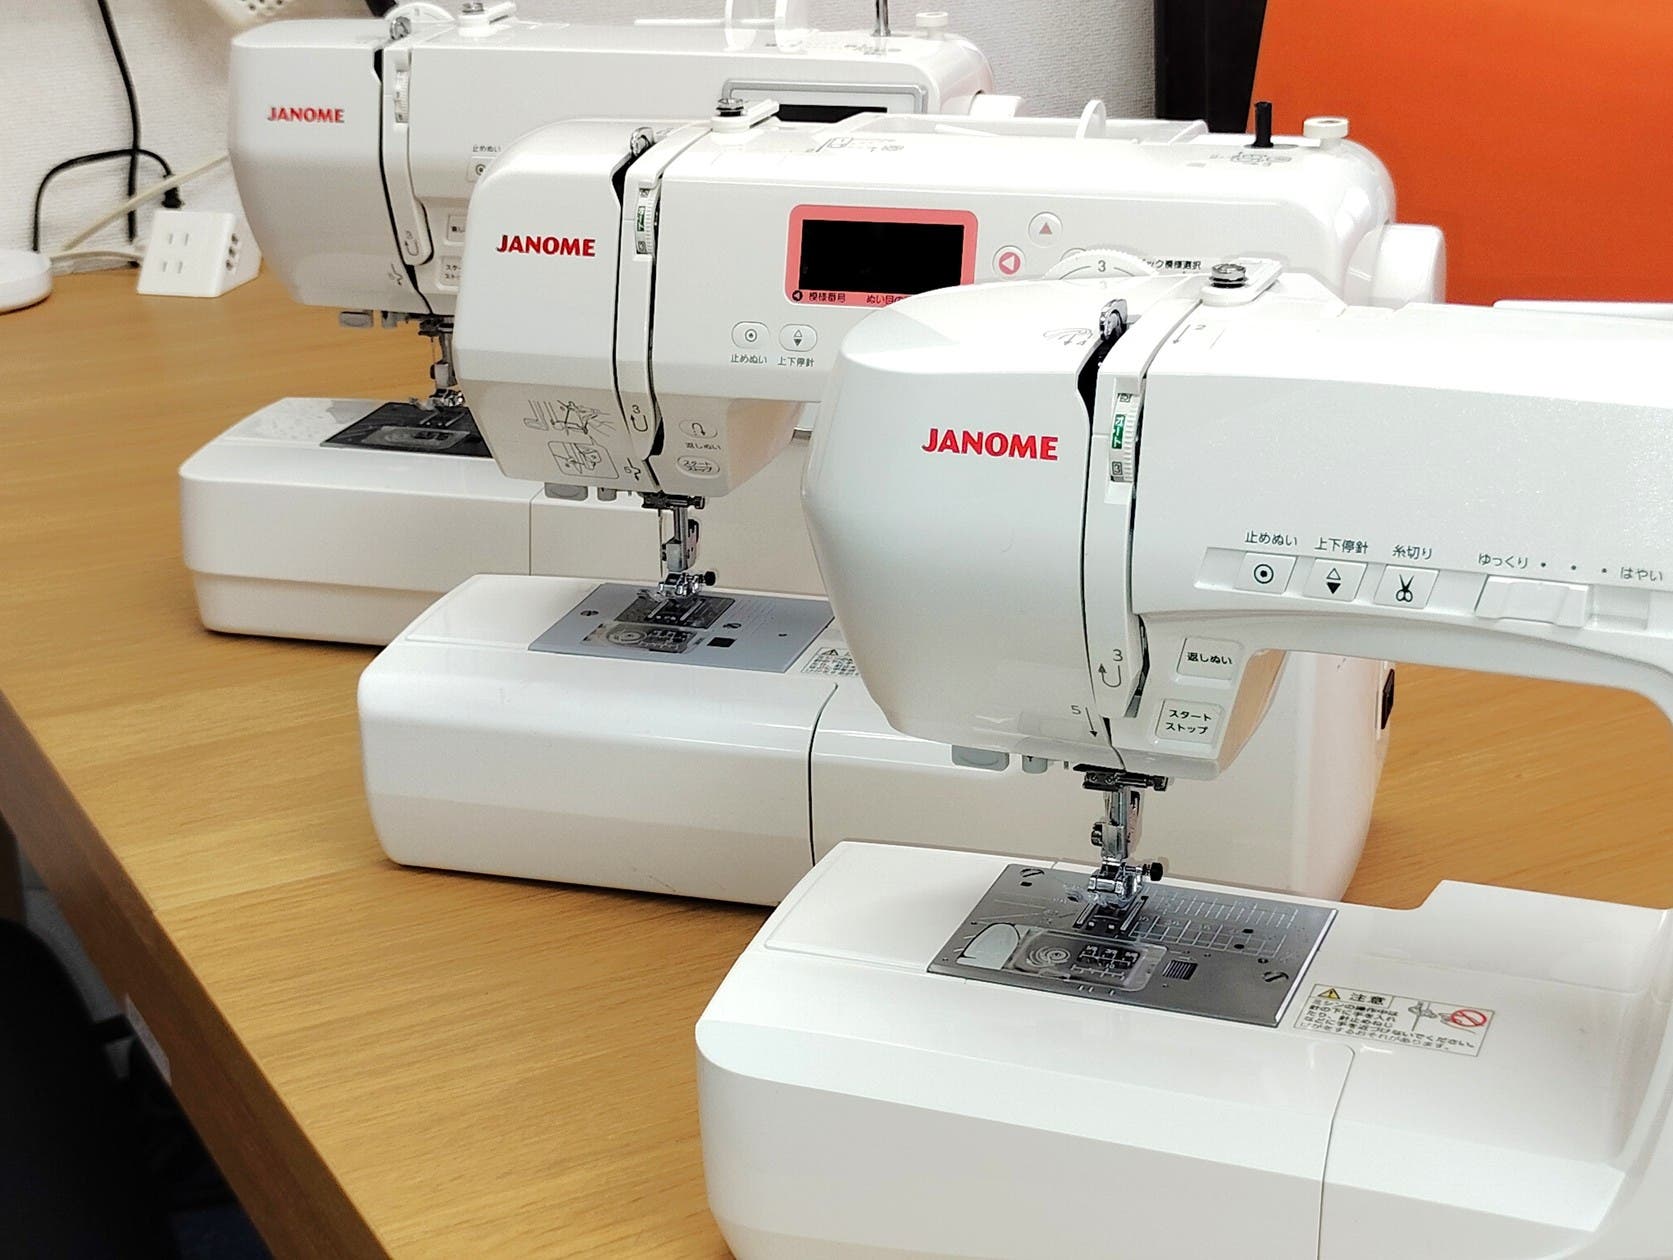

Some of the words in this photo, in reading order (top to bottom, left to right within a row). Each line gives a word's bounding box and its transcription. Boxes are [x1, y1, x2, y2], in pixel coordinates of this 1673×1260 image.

[268, 107, 344, 123] JANOME
[497, 235, 596, 257] JANOME
[1097, 259, 1107, 273] 3
[730, 354, 768, 364] 止めぬい
[631, 404, 641, 414] 3
[1113, 415, 1125, 449] オート
[922, 428, 1059, 461] JANOME
[1245, 530, 1297, 547] 止めぬい
[1314, 536, 1368, 555] 上下停針
[1392, 544, 1432, 560] 糸切り
[1478, 553, 1528, 570] ゆっくり
[1620, 566, 1663, 582] はやい
[1113, 649, 1124, 662] 3
[1187, 651, 1233, 665] 返しぬい
[1071, 705, 1082, 715] 5
[1169, 709, 1212, 722] スタート
[1165, 722, 1209, 735] ストップ
[1350, 992, 1385, 1005] 注意
